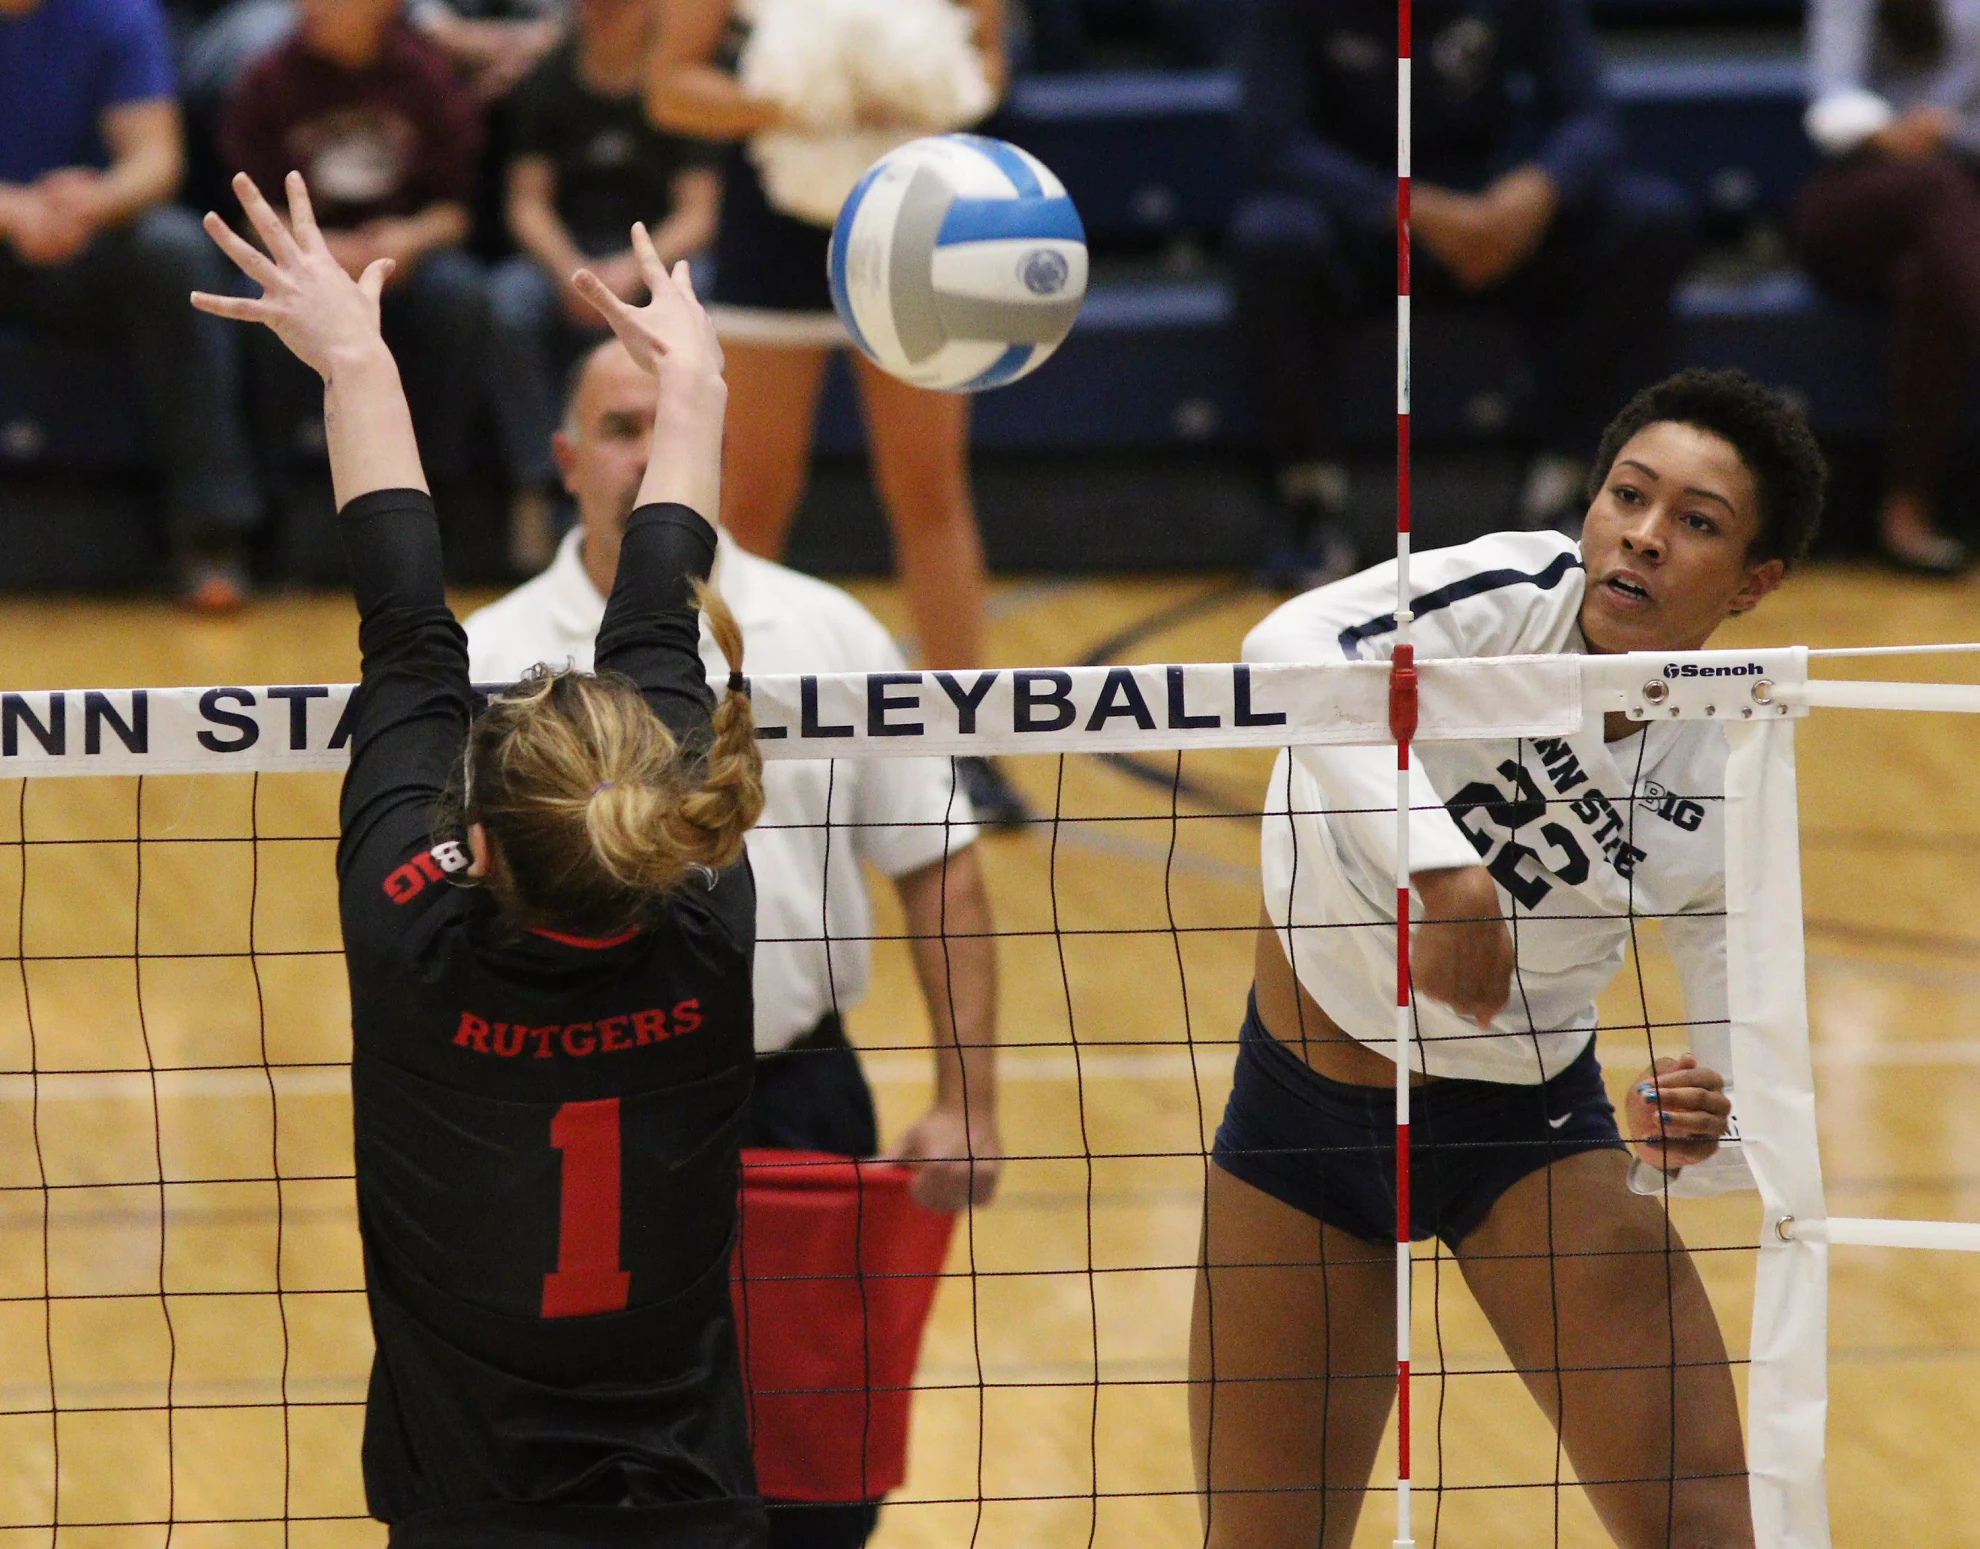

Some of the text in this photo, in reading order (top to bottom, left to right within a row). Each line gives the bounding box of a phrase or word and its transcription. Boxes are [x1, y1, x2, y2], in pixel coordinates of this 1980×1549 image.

[1680, 662, 1764, 677] Senoh
[1527, 737, 1589, 795] NN
[1443, 758, 1591, 911] 22
[452, 998, 704, 1058] RUTGERS
[540, 1096, 631, 1319] 1
